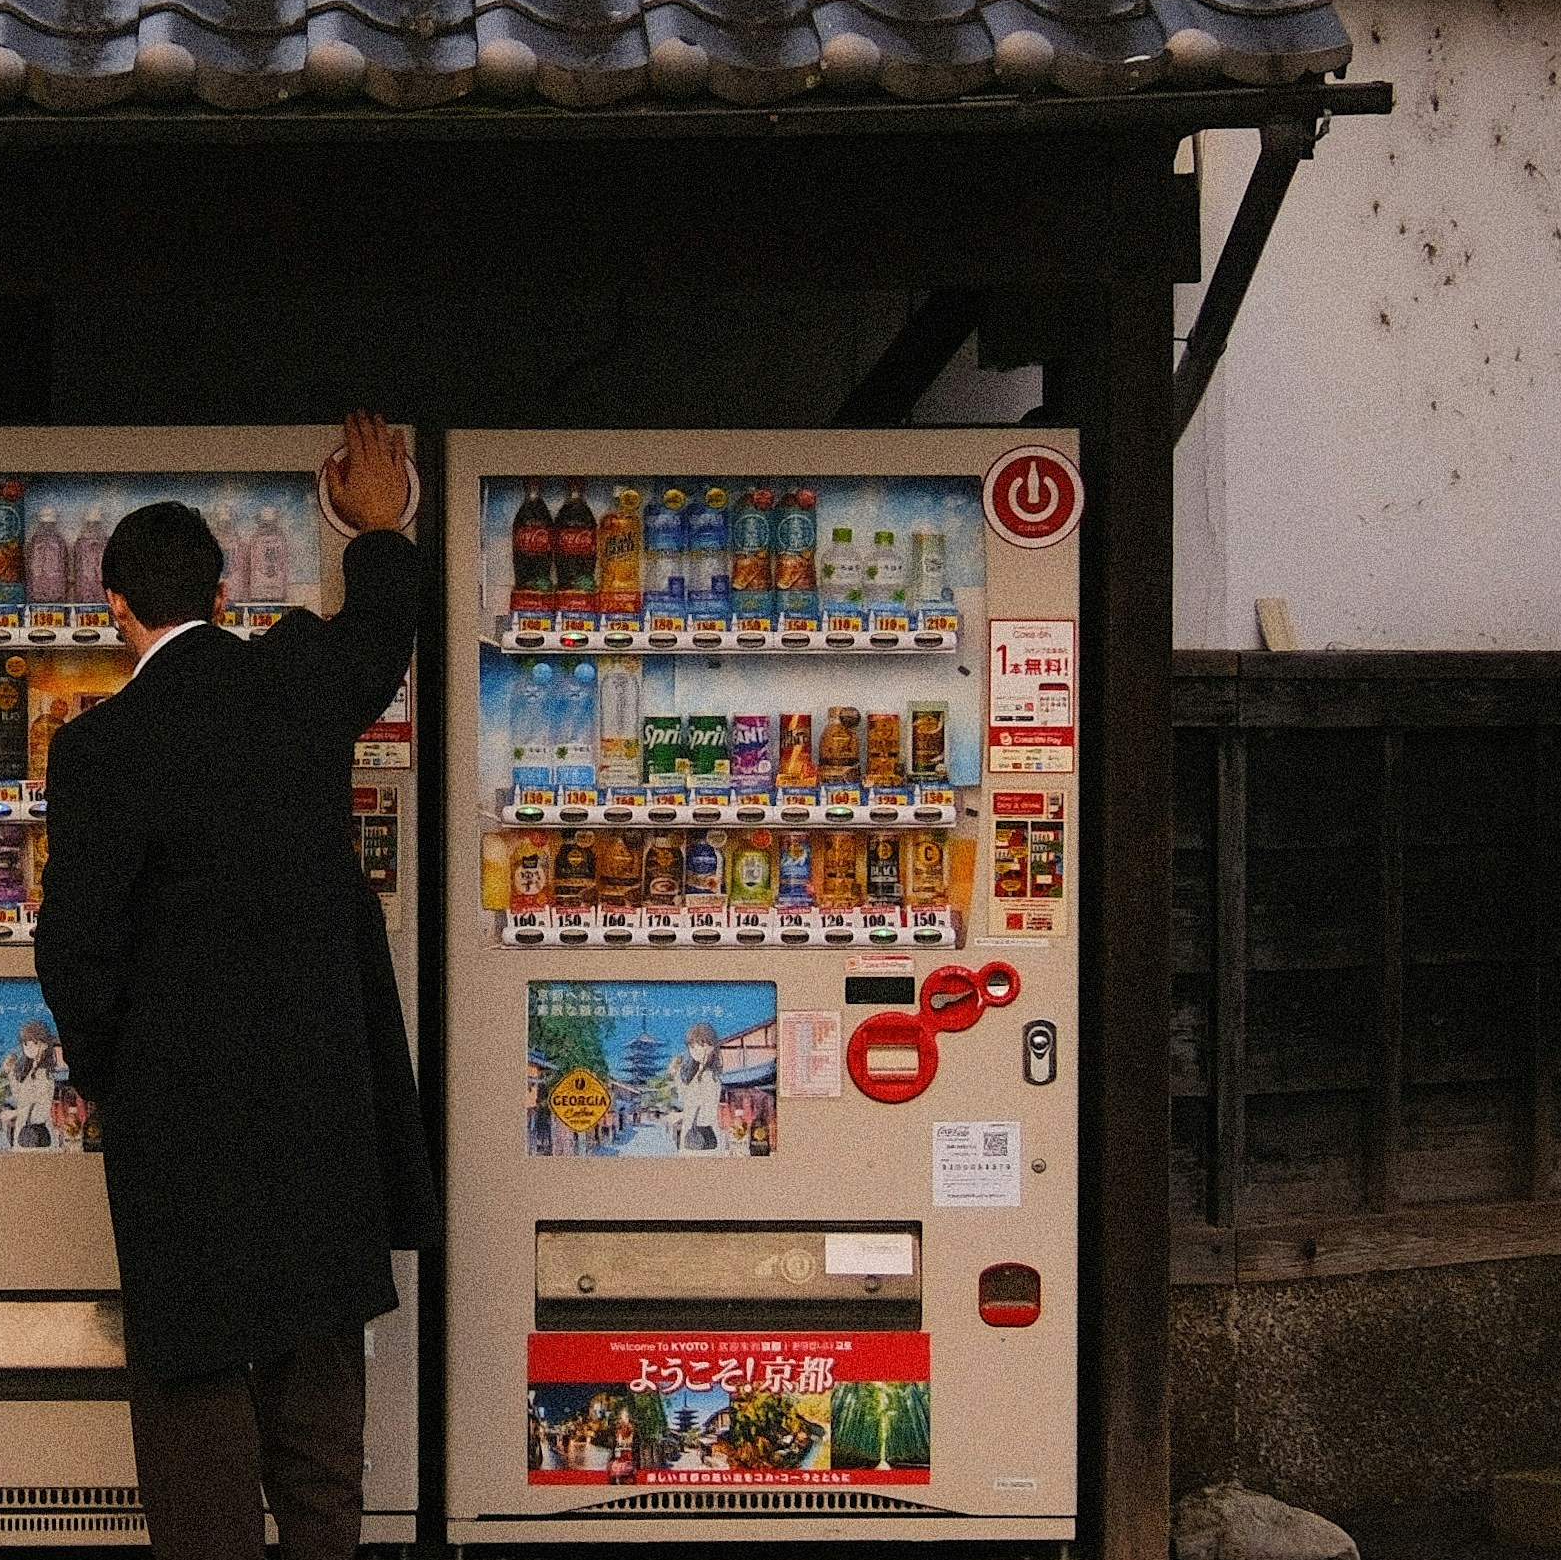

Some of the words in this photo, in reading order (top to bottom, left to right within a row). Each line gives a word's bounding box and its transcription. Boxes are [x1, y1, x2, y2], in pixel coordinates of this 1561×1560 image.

[644, 724, 682, 750] Spri
[552, 1094, 608, 1107] GEORGIA
[610, 1342, 656, 1352] Welcome
[657, 1342, 669, 1352] To
[671, 1342, 709, 1351] KYOTO
[630, 1355, 836, 1392] ようこそ!京都
